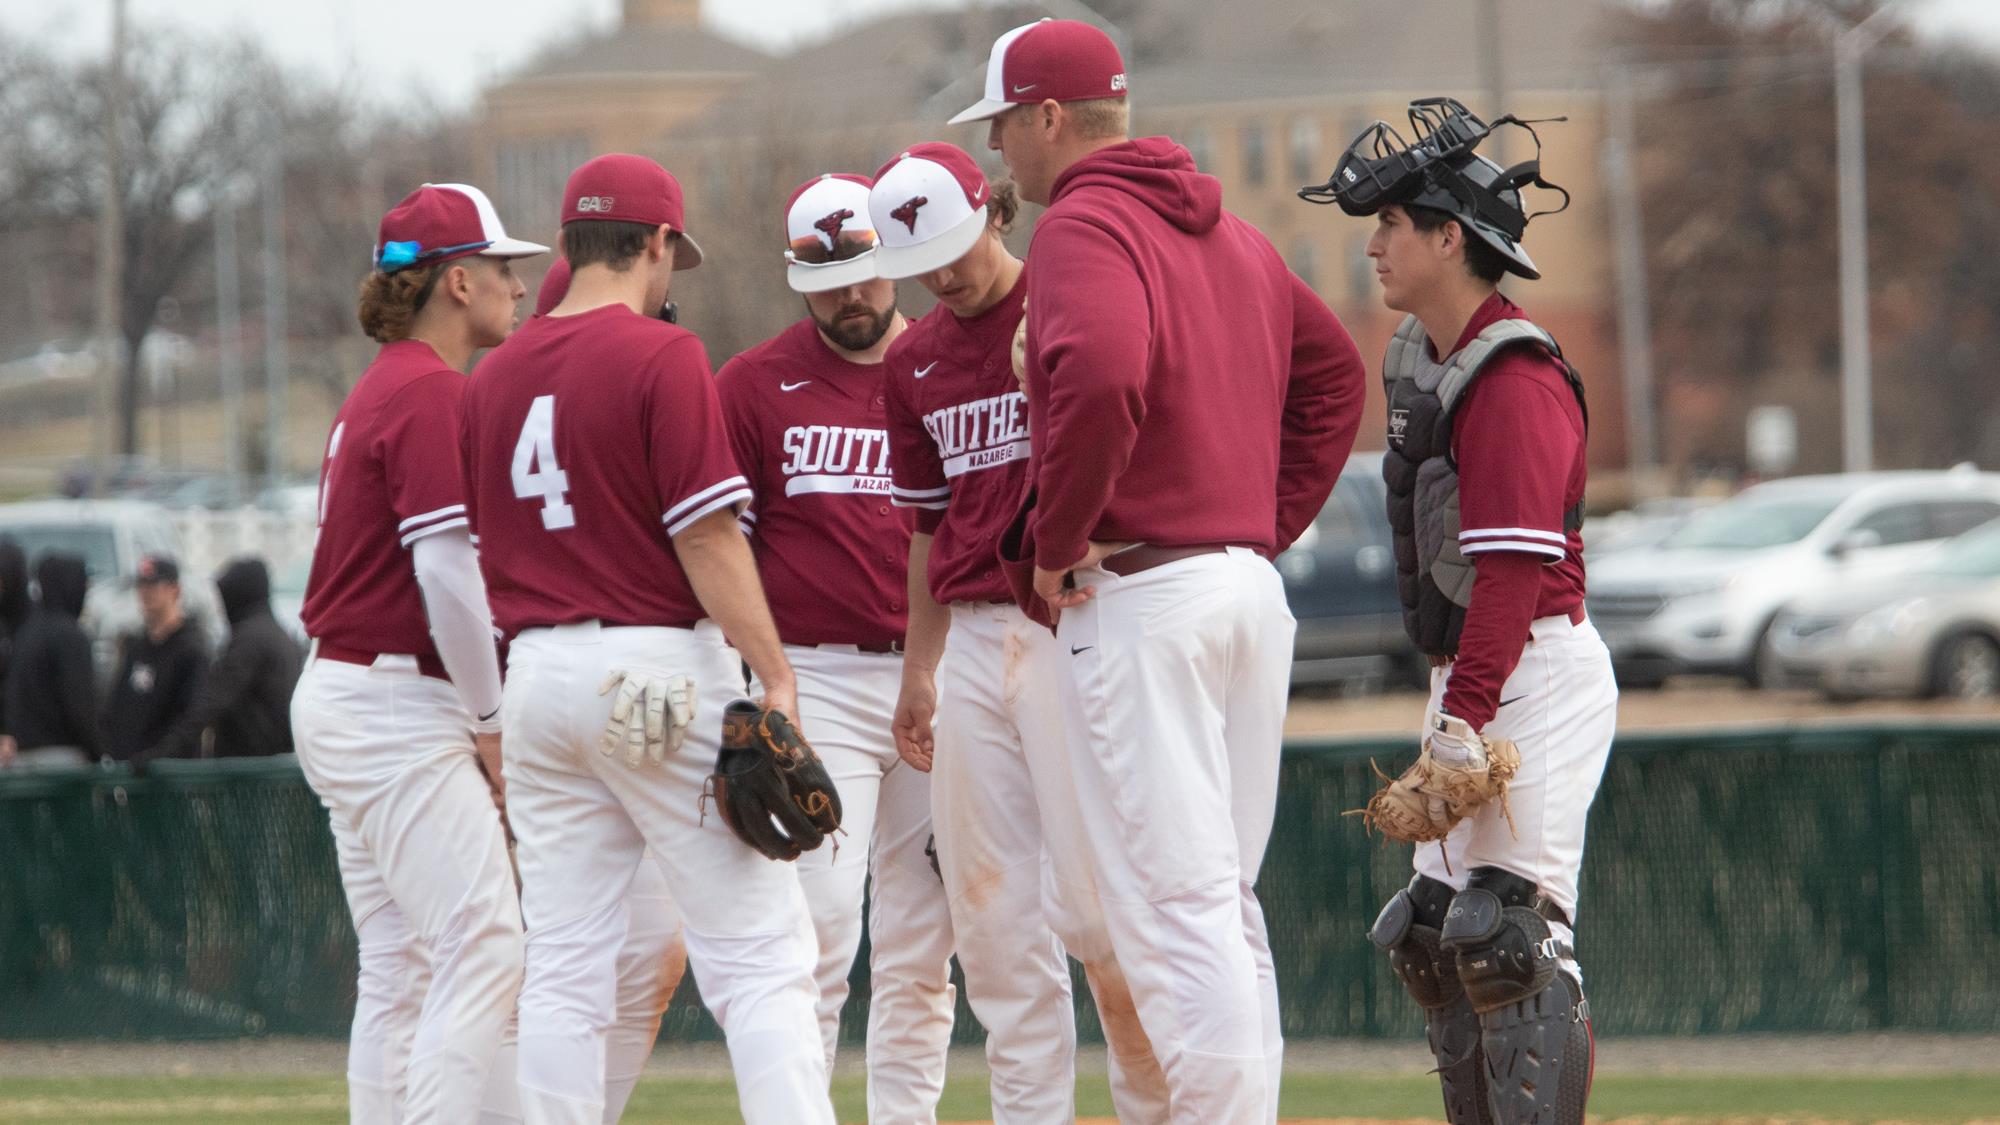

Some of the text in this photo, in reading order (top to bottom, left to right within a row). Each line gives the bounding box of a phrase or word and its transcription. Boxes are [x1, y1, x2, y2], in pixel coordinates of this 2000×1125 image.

[1342, 166, 1356, 182] PRO
[576, 196, 614, 212] GAC
[922, 391, 1030, 458] SOUTHE
[510, 394, 576, 530] 4
